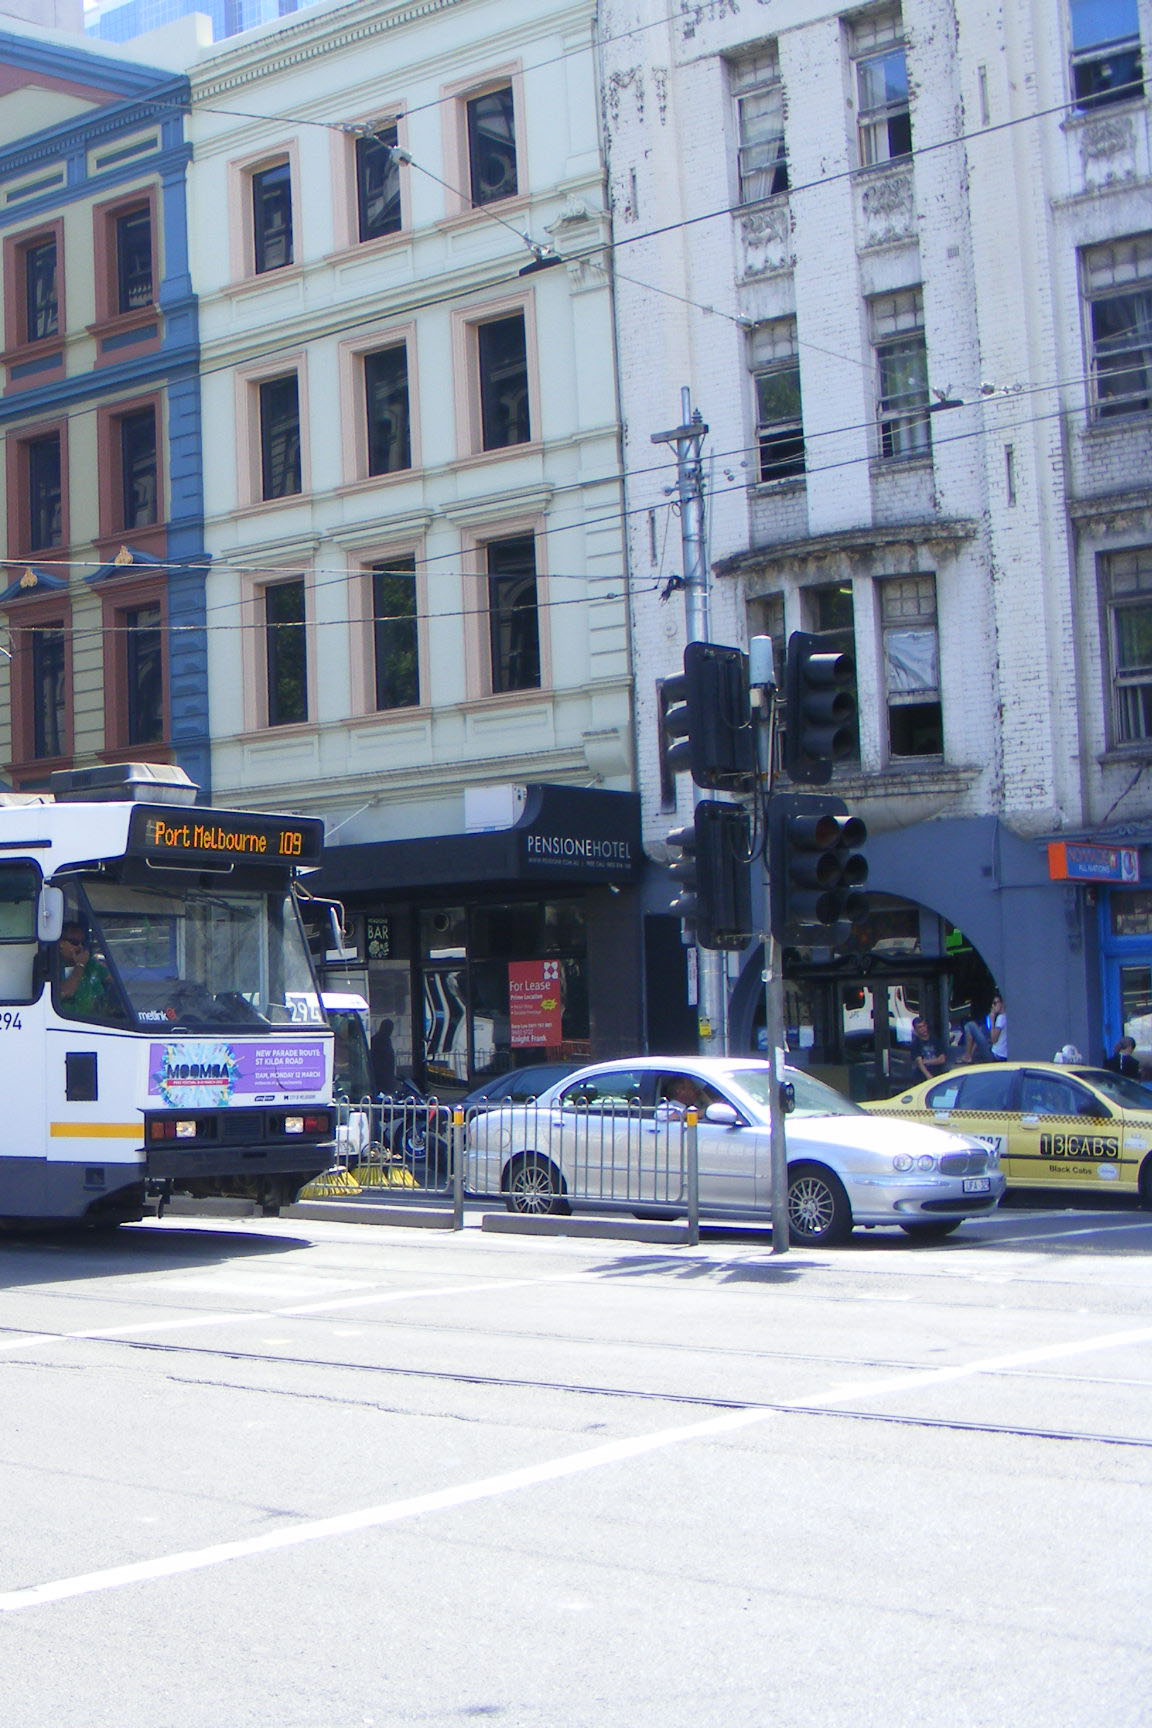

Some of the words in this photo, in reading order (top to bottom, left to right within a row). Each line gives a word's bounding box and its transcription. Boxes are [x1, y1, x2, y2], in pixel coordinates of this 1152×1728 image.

[154, 821, 191, 848] Port
[194, 824, 267, 853] Melbourne
[278, 831, 302, 855] 109
[368, 925, 388, 939] BAR
[509, 981, 523, 992] For
[525, 980, 551, 991] Lease
[138, 1011, 168, 1021] metlink
[290, 1002, 322, 1022] 294
[167, 1063, 229, 1079] MOOMBA
[1049, 1165, 1070, 1173] Black
[1072, 1166, 1092, 1175] Cabs
